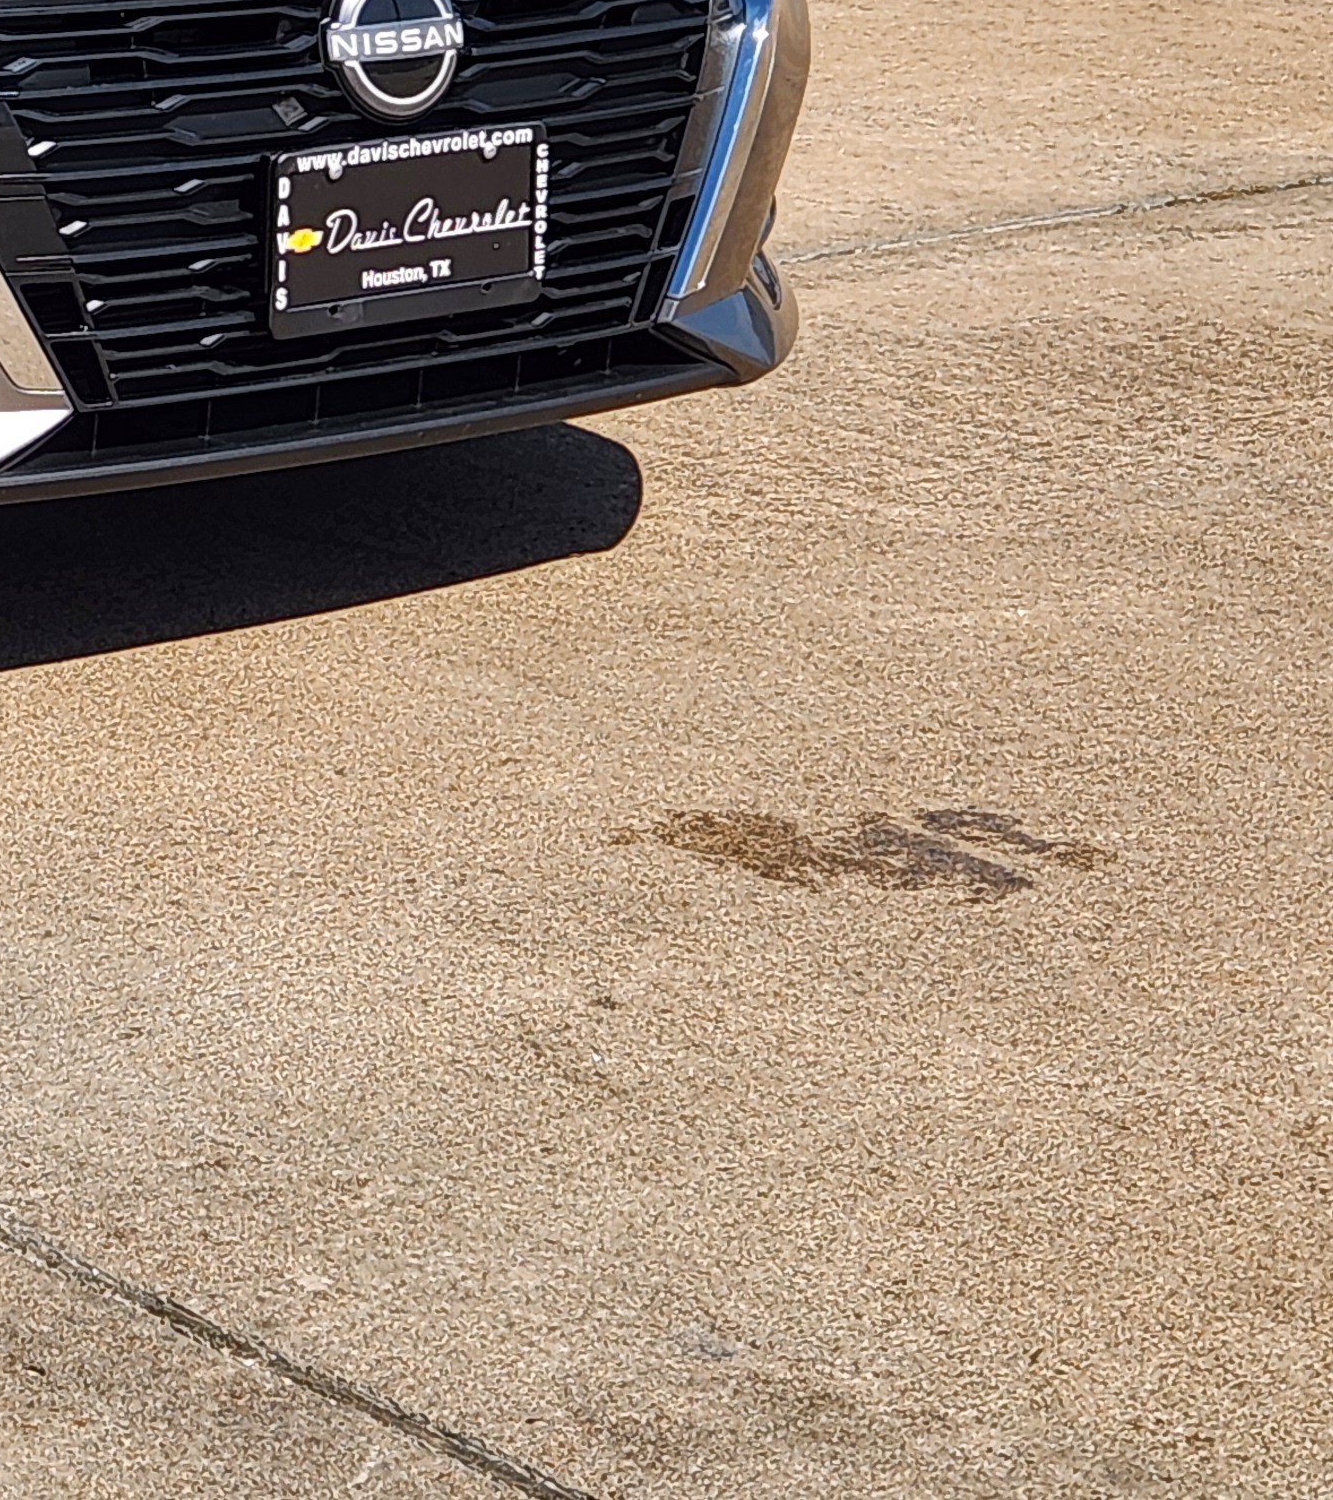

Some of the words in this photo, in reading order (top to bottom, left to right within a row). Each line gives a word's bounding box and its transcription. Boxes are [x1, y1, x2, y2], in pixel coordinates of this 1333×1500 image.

[331, 21, 463, 57] NISSAN
[296, 127, 533, 173] www.davischevrolet.com
[326, 208, 403, 255] Davis
[403, 197, 533, 242] Chevrolet
[533, 143, 550, 281] CHEVROLET
[275, 176, 291, 311] DAVIS
[361, 264, 429, 290] Houston,
[429, 258, 452, 278] TX
